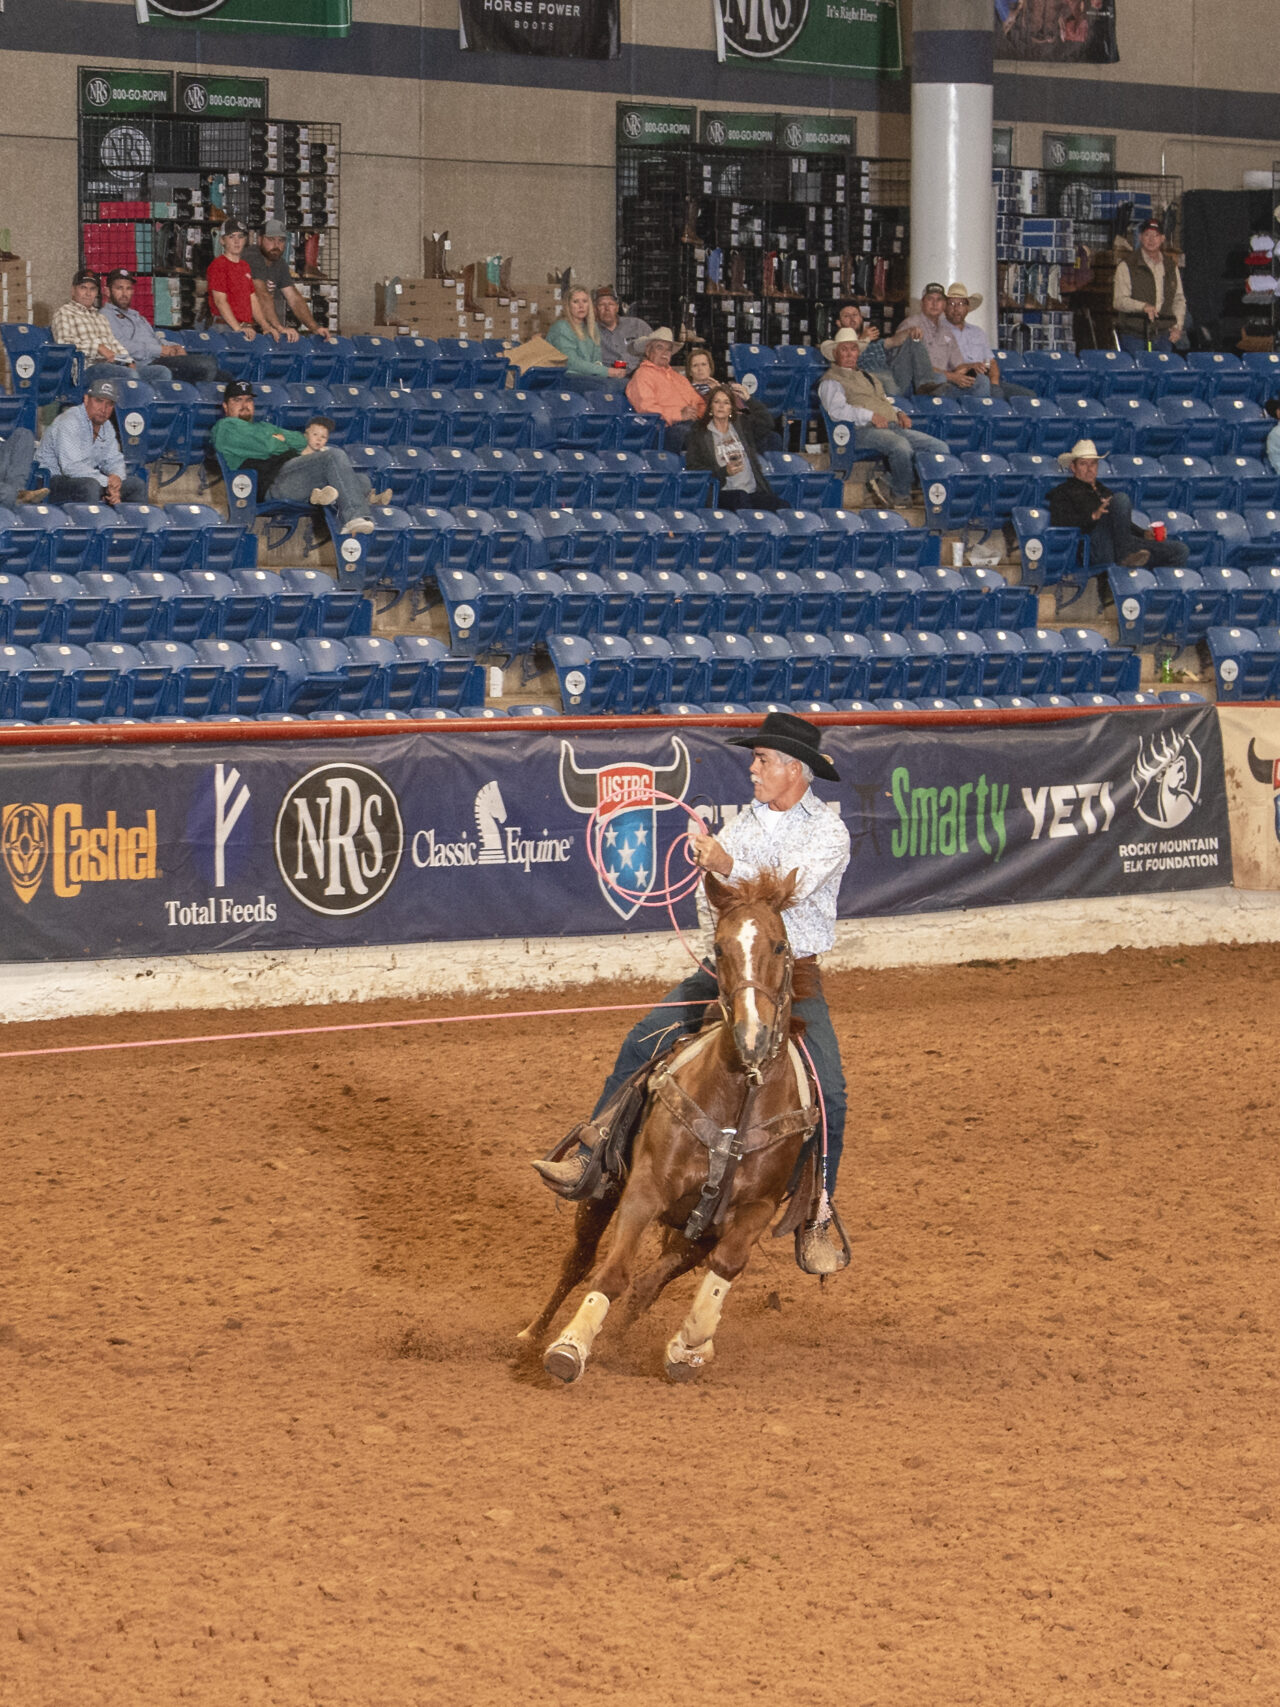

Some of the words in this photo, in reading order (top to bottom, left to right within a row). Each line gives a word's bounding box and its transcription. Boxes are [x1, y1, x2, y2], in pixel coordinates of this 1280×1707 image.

[484, 0, 533, 14] HORSE
[538, 3, 581, 17] POWER
[514, 20, 554, 31] BOOTS
[90, 81, 108, 102] NRS
[112, 88, 168, 102] 800-GO-ROPIN
[188, 87, 205, 109] NRS
[209, 94, 261, 108] 800-GO-ROPIN
[601, 774, 650, 803] USTRC
[891, 766, 1010, 863] Smarty
[1021, 782, 1116, 841] YETI
[53, 803, 158, 898] Cashel
[293, 777, 383, 896] NRS
[412, 828, 478, 868] Classic
[504, 826, 570, 873] Equine
[1119, 842, 1158, 858] ROCKY
[1159, 837, 1219, 854] MOUNTAIN
[1123, 860, 1143, 874] ELK
[1145, 854, 1219, 872] FOUNDATION
[164, 897, 216, 926] Total
[219, 895, 278, 923] Feeds
